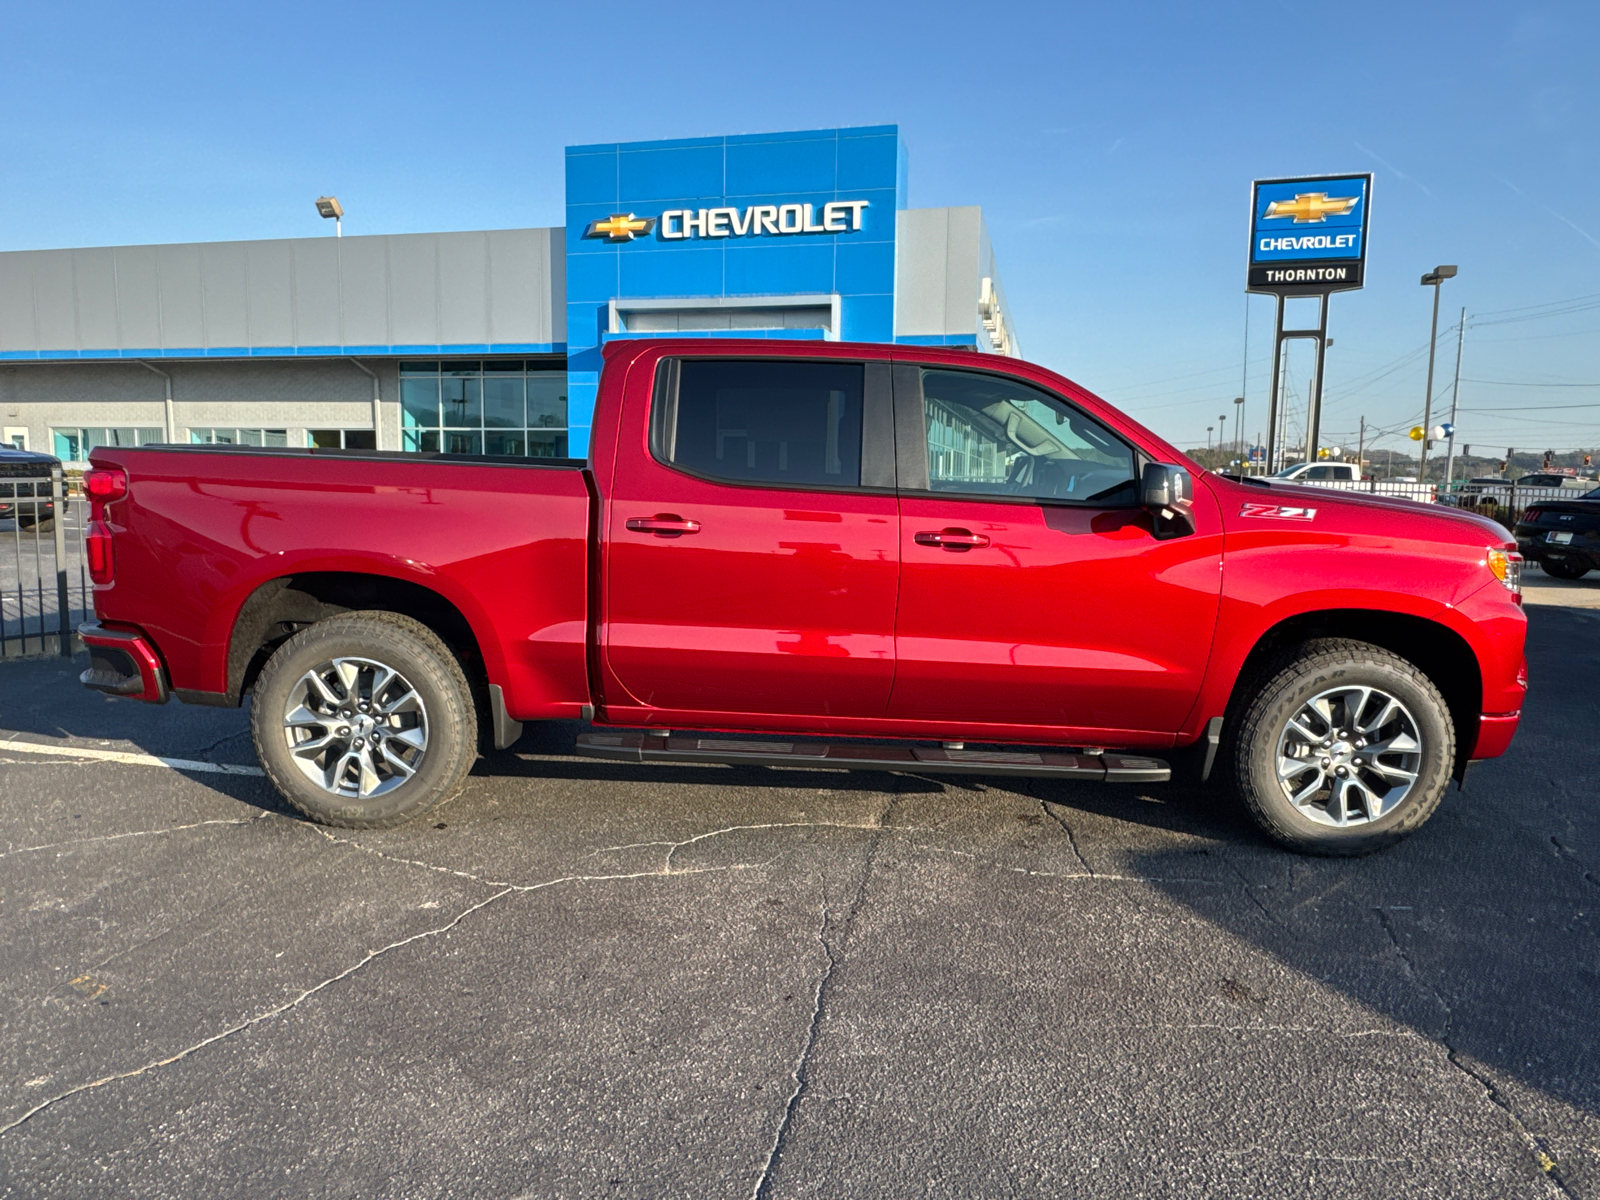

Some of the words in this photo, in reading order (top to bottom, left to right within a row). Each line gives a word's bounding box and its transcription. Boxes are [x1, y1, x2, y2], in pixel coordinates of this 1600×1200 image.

[661, 200, 870, 239] CHEVROLET
[1260, 234, 1356, 251] CHEVROLET
[1266, 267, 1347, 282] THORNTON
[1239, 503, 1317, 522] Z71
